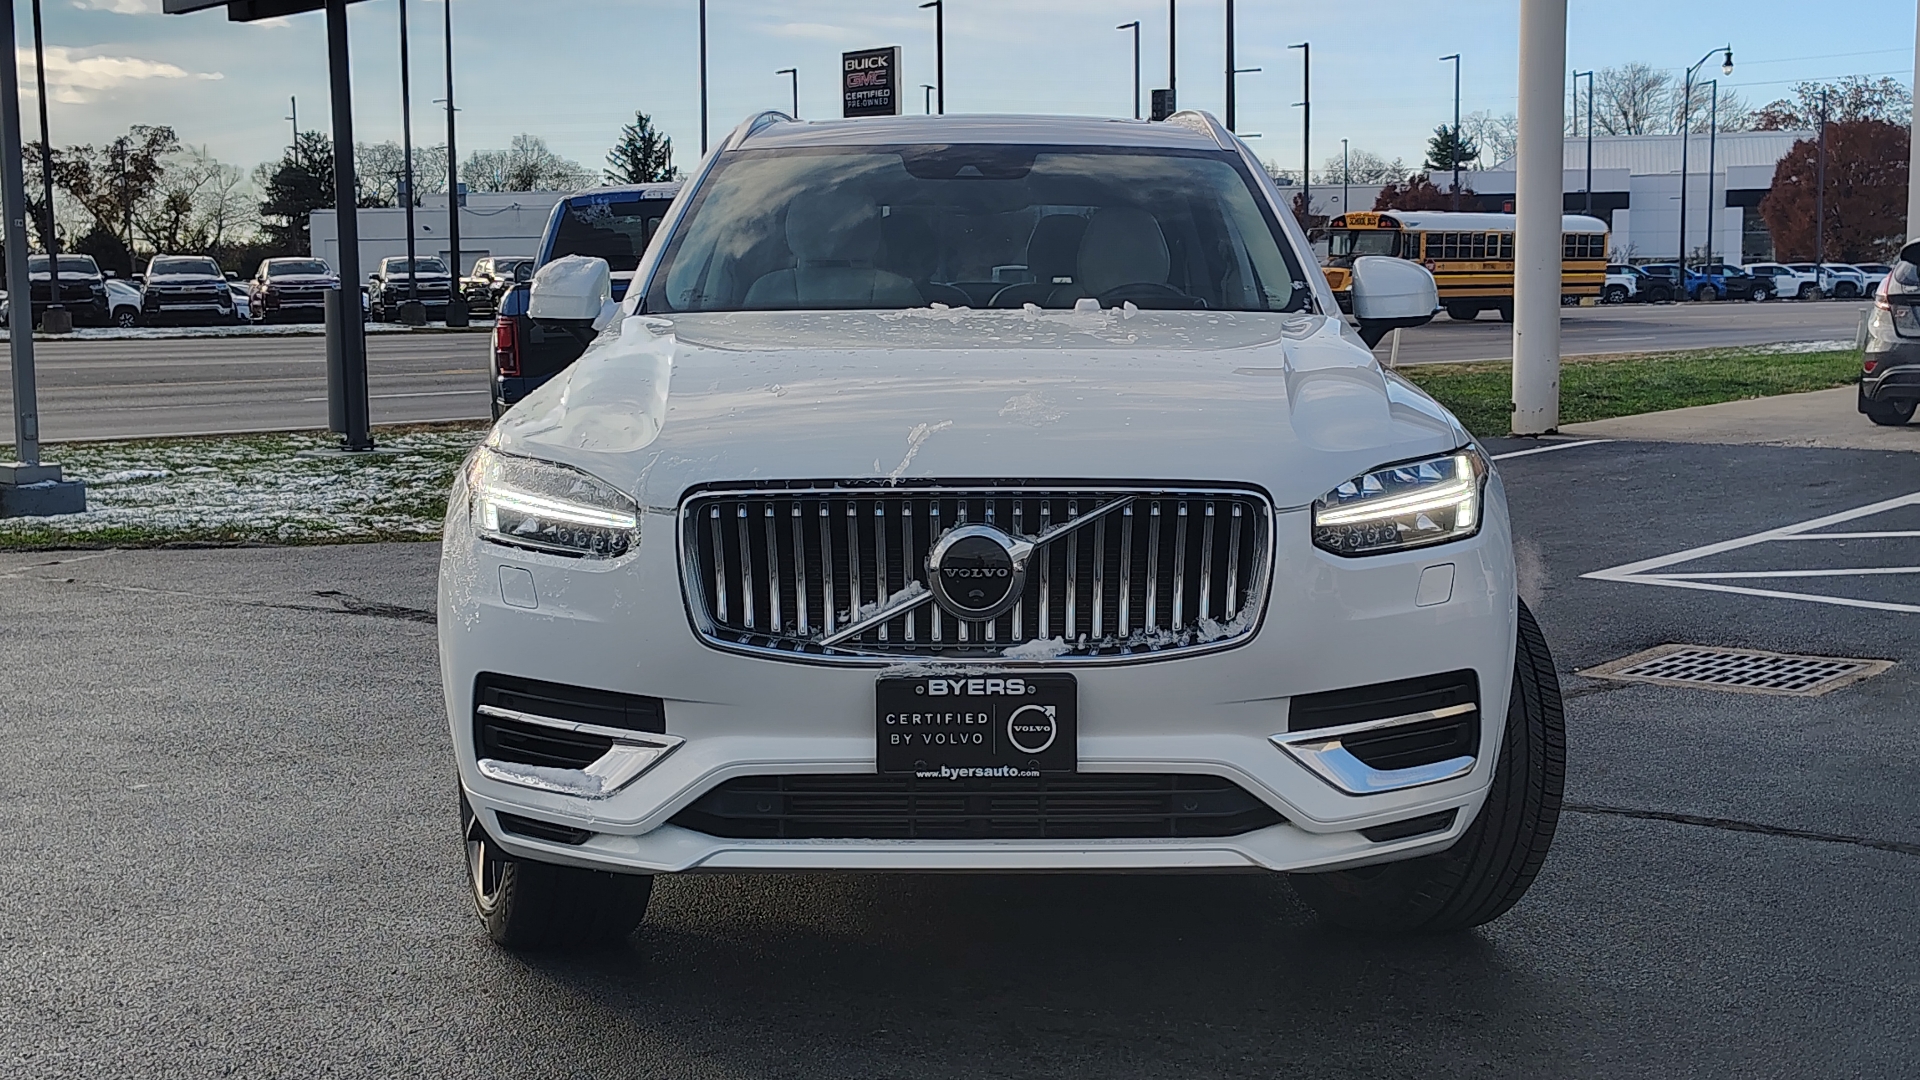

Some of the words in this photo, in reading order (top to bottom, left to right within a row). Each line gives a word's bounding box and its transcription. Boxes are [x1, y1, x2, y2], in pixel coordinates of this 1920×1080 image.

[845, 56, 889, 71] BUICK
[847, 70, 887, 88] GMC
[845, 89, 891, 101] CERTIFIED
[847, 97, 889, 108] PRE-OWNED
[943, 568, 1009, 578] VOLVO
[928, 679, 1026, 695] BYERS
[885, 713, 988, 725] CERTIFIED
[890, 733, 913, 745] BY
[921, 733, 983, 745] VOLVO
[915, 765, 1040, 780] www.byersauto.com
